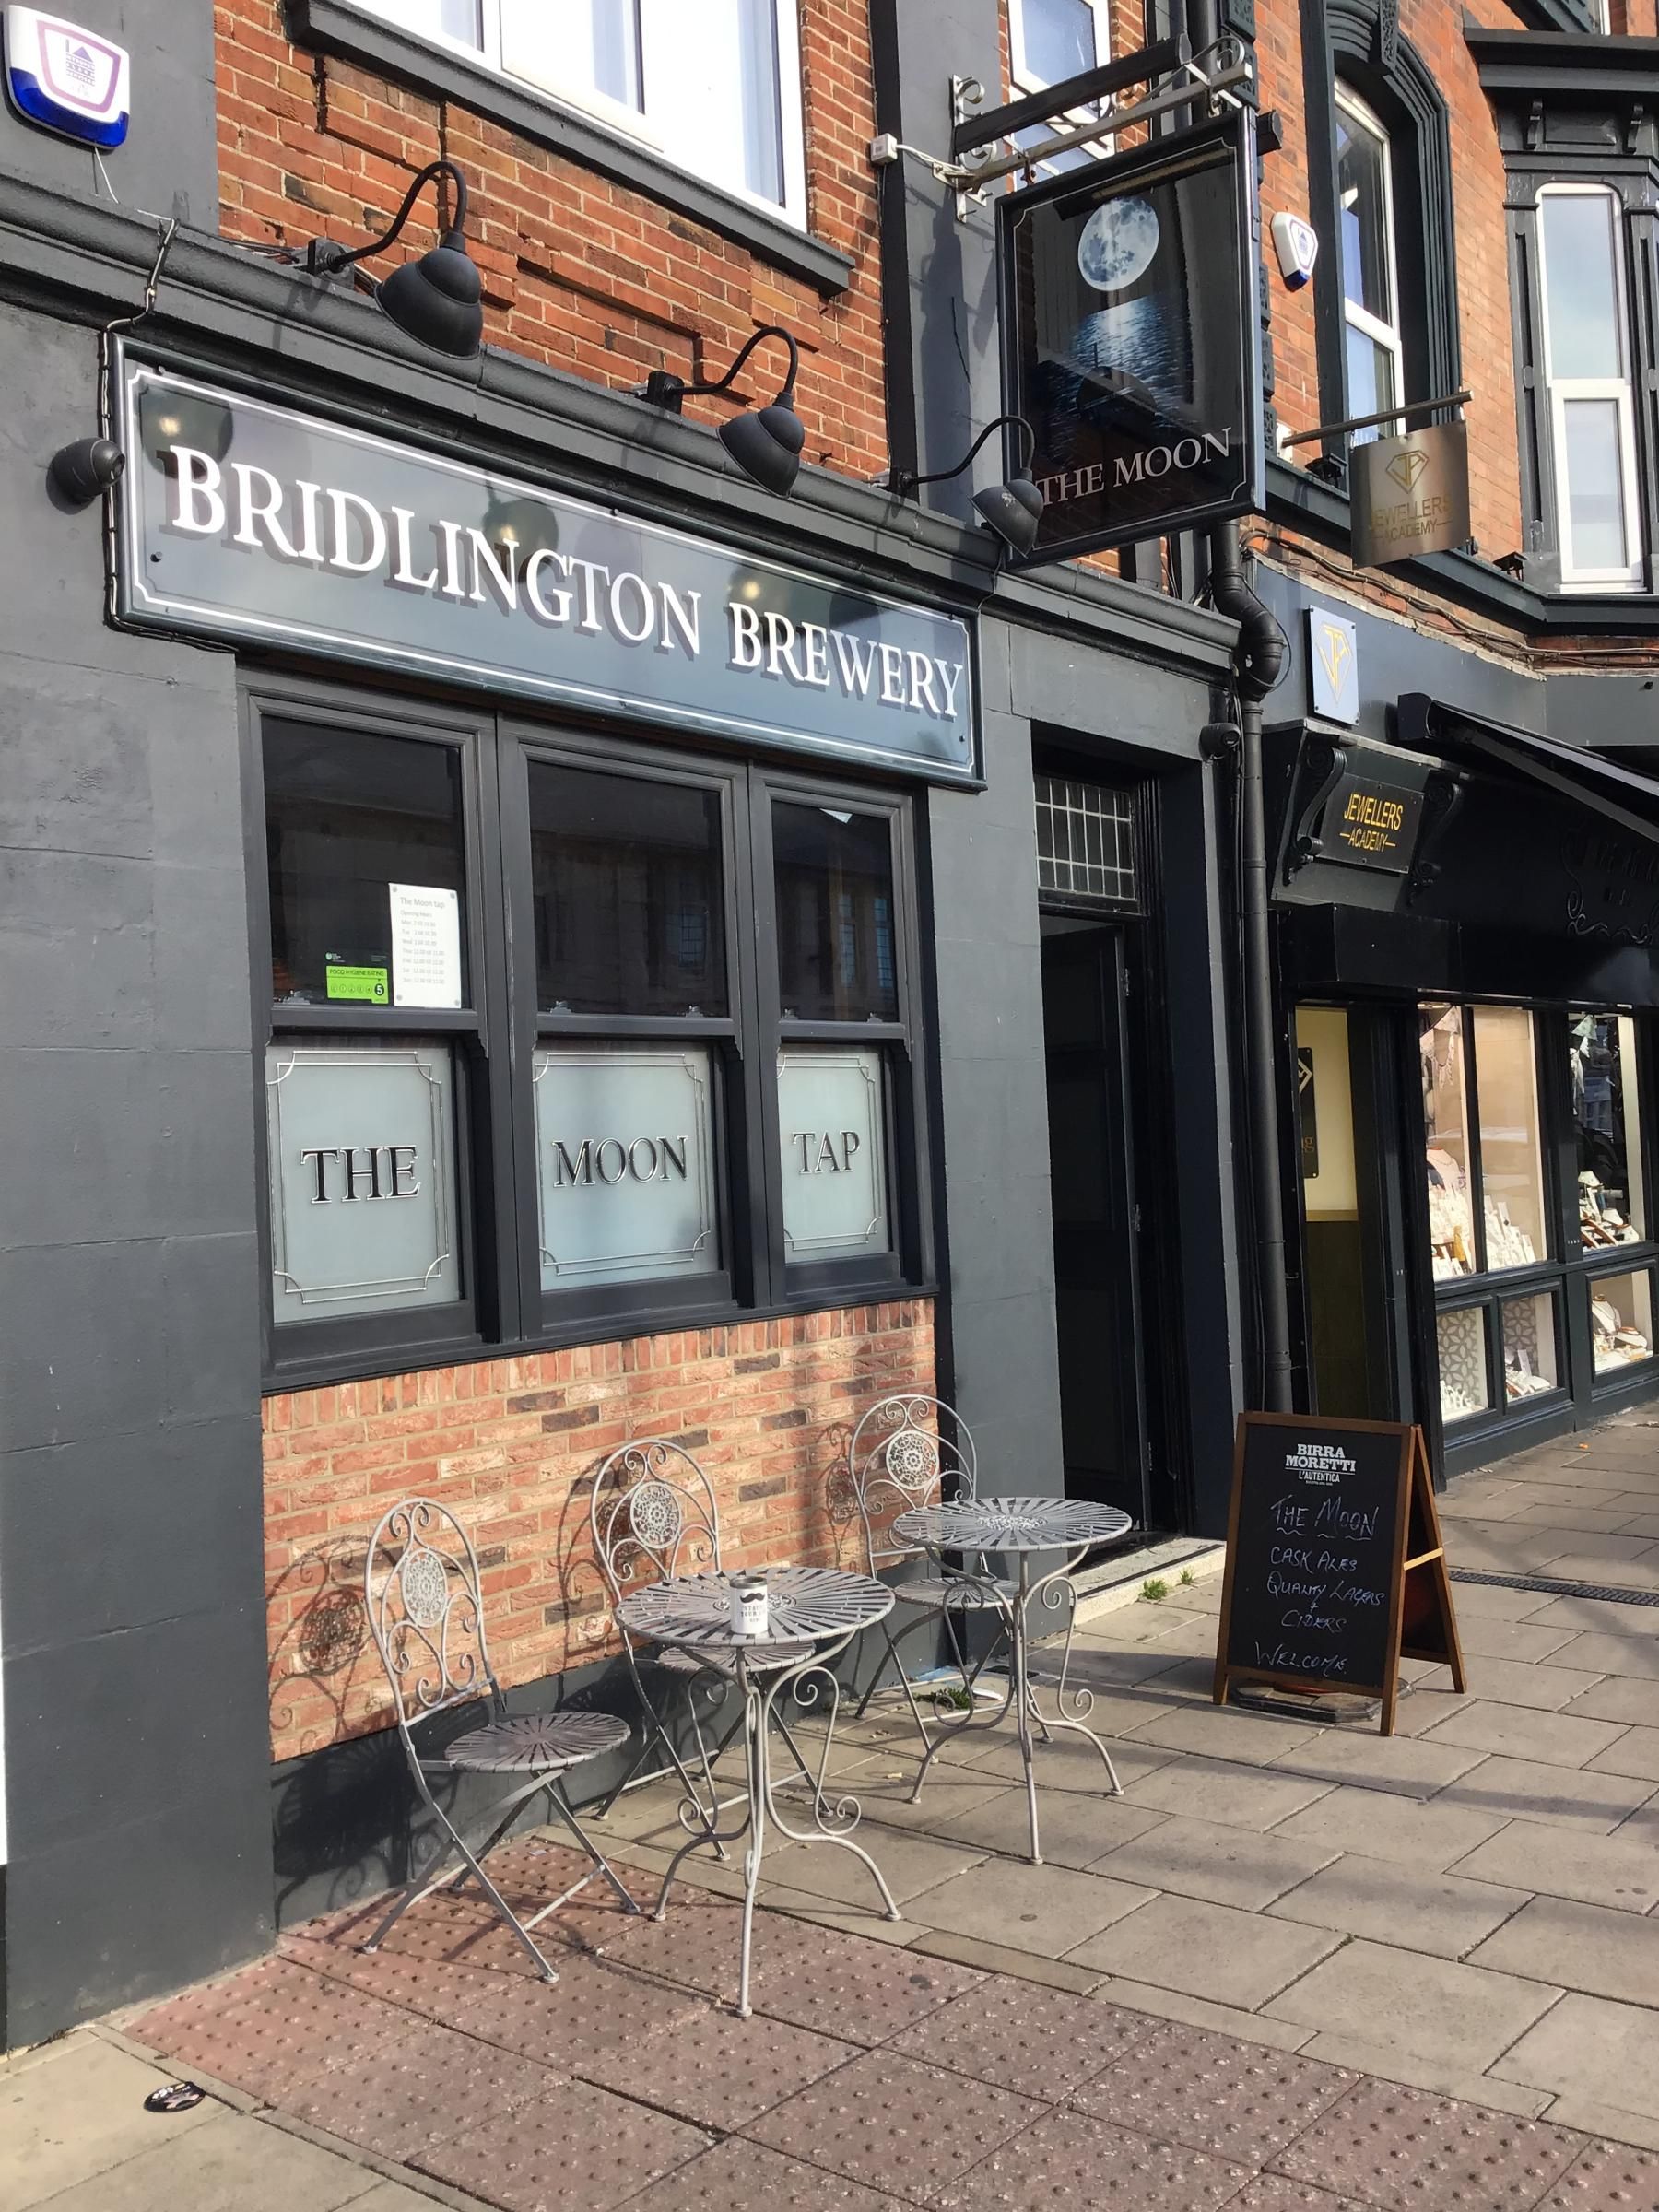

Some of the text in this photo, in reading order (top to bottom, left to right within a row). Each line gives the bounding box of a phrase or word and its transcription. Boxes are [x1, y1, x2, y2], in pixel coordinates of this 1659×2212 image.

[1035, 427, 1232, 506] THE MOON
[168, 444, 964, 717] BRIDLINGTON BREWERY
[1343, 793, 1404, 830] JEWELLERS
[1347, 828, 1389, 853] ACADEMY
[400, 897, 413, 906] The
[414, 898, 433, 907] Moon
[376, 984, 382, 994] 5
[300, 1130, 861, 1206] THE MOON TAP
[1285, 1454, 1357, 1472] MORETTI
[1297, 1443, 1346, 1459] BIRRA
[1299, 1470, 1341, 1483] L'AUTENTICA
[1270, 1547, 1314, 1574] CASK
[1281, 1609, 1347, 1633] CIDERS
